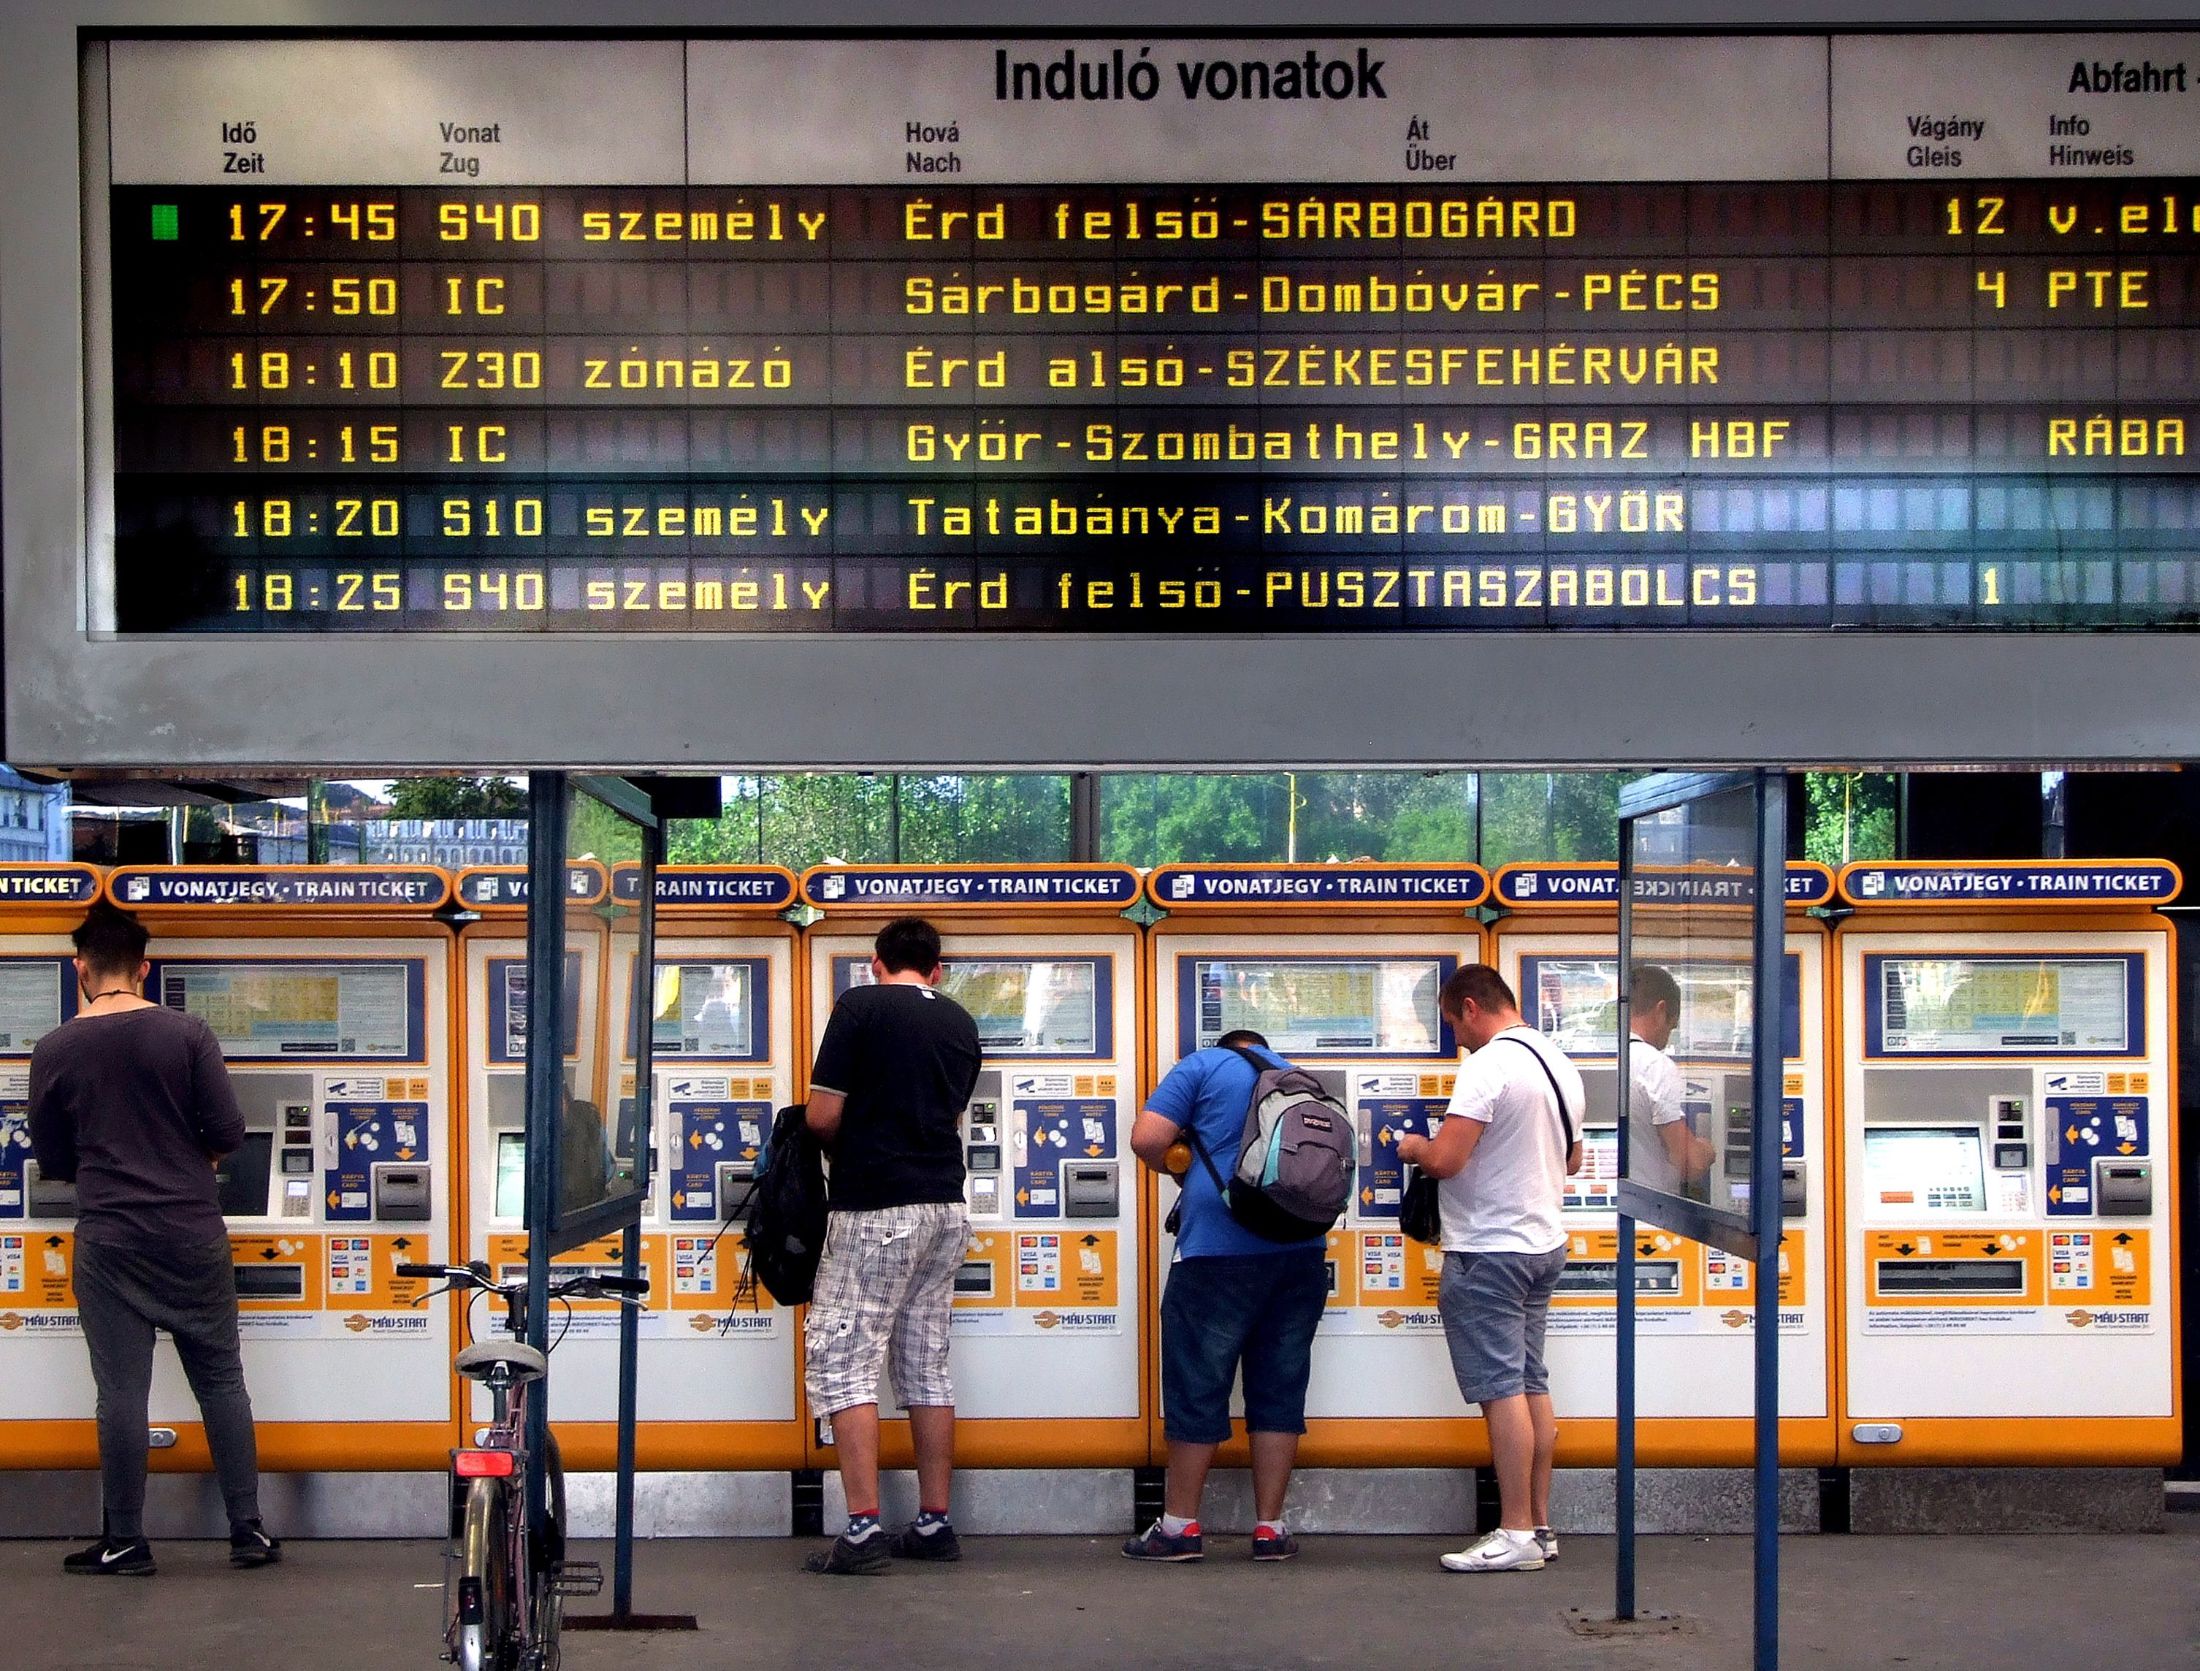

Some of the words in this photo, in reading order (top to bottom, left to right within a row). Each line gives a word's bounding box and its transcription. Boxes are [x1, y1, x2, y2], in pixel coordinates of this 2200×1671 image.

[995, 47, 1159, 101] Induló
[1177, 47, 1388, 101] vonatok
[2068, 61, 2187, 93] Abfahrt
[222, 121, 257, 143] Idő
[440, 122, 500, 143] Vonat
[906, 119, 960, 143] Hová
[1407, 115, 1430, 141] Át
[1907, 115, 1985, 141] Vágány
[2049, 114, 2090, 136] Info
[223, 152, 265, 174] Zeit
[440, 152, 480, 177] Zug
[906, 152, 961, 173] Nach
[1406, 142, 1457, 171] Über
[1906, 145, 1962, 168] Gleis
[2049, 144, 2135, 166] Hinweis
[229, 204, 397, 241] 17:45
[440, 204, 541, 241] S40
[582, 198, 827, 241] személy
[905, 198, 1006, 240] Érd
[2048, 197, 2200, 234] v.el
[229, 279, 398, 316] 17:50
[446, 279, 506, 316] IC
[1977, 271, 2006, 309] 4
[2048, 271, 2149, 309] PTE
[230, 353, 398, 389] 18:10
[441, 353, 542, 389] Z30
[584, 346, 793, 389] zónázó
[905, 346, 1007, 388] Érd
[232, 427, 399, 463] 18:15
[449, 427, 507, 463] IC
[1692, 421, 1791, 459] HBF
[2049, 414, 2186, 457] RÁBA
[233, 500, 400, 537] 18:20
[443, 500, 544, 537] S10
[586, 494, 829, 537] személy
[234, 574, 402, 611] 18:25
[444, 574, 546, 611] S40
[588, 567, 830, 611] személy
[908, 568, 1009, 610] Érd
[1984, 568, 2000, 605] 1
[14, 877, 82, 894] TICKET
[159, 880, 279, 898] VONATJEGY
[294, 881, 355, 898] TRAIN
[358, 880, 429, 898] TICKET
[655, 880, 702, 896] RAIN
[706, 880, 776, 896] TICKET
[855, 879, 973, 895] VONATJEGY
[988, 878, 1049, 894] TRAIN
[1052, 878, 1121, 894] TICKET
[1203, 878, 1322, 894] VONATJEGY
[1337, 878, 1398, 894] TRAIN
[1401, 878, 1470, 894] TICKET
[1547, 878, 1619, 894] VONAT
[1894, 875, 2013, 892] VONATJEGY
[2028, 875, 2089, 890] TRAIN
[2092, 875, 2162, 890] TICKET
